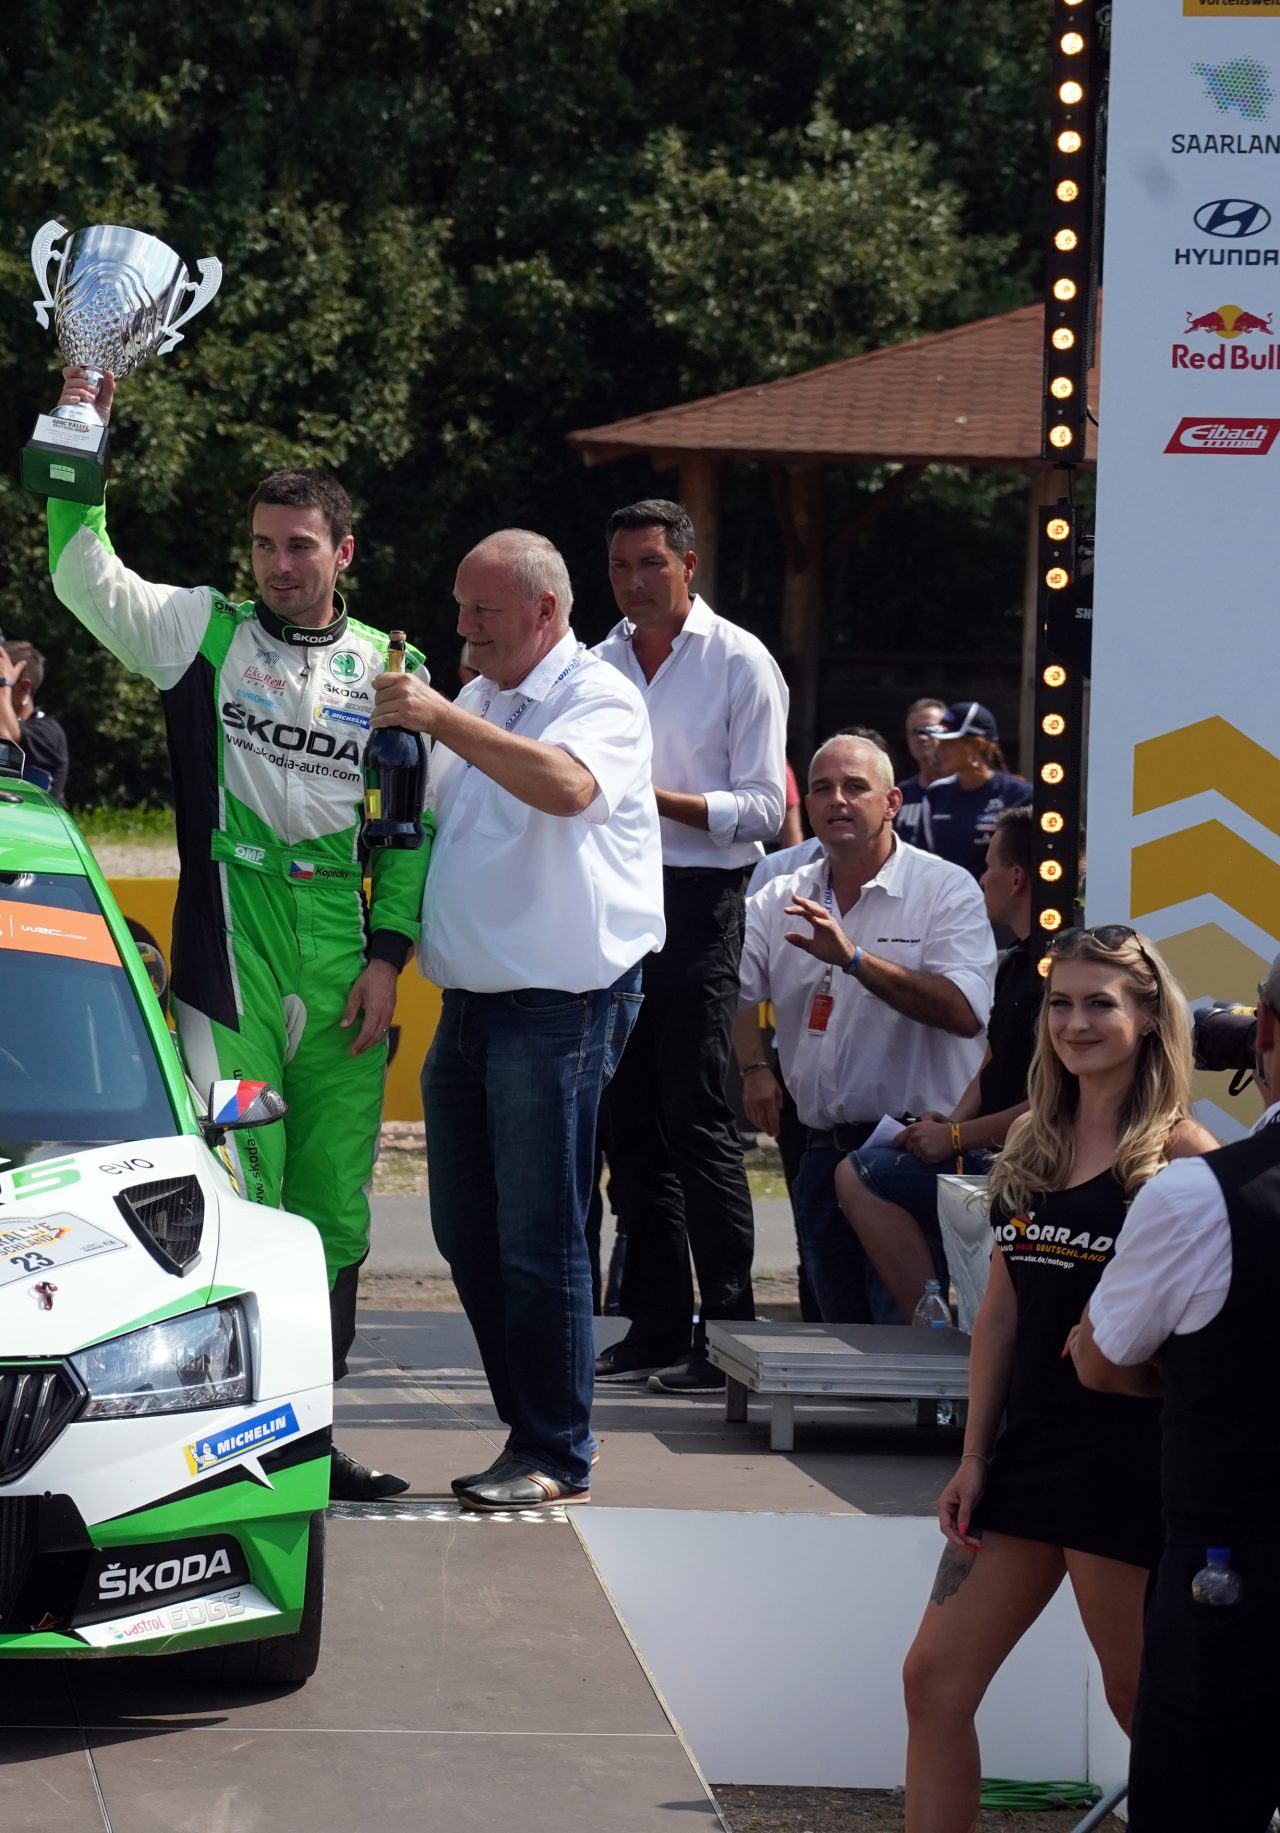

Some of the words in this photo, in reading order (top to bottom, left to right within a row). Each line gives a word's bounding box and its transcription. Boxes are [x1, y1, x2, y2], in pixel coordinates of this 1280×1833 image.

[1171, 134, 1280, 154] SAARLAN
[1174, 248, 1279, 266] HYUNDA
[1172, 344, 1226, 370] Red
[1179, 424, 1268, 448] Eibach
[292, 632, 334, 643] ŠKODA
[323, 683, 369, 701] ŠKODA
[222, 701, 360, 766] ŠKODA
[235, 845, 265, 862] OMP
[98, 1157, 155, 1176] evo
[10, 1251, 55, 1273] 23
[1036, 1243, 1107, 1262] DEUTSCHLAND
[216, 1415, 287, 1456] MICHELIN
[98, 1549, 232, 1600] ŠKODA
[166, 1591, 246, 1630] EDGE
